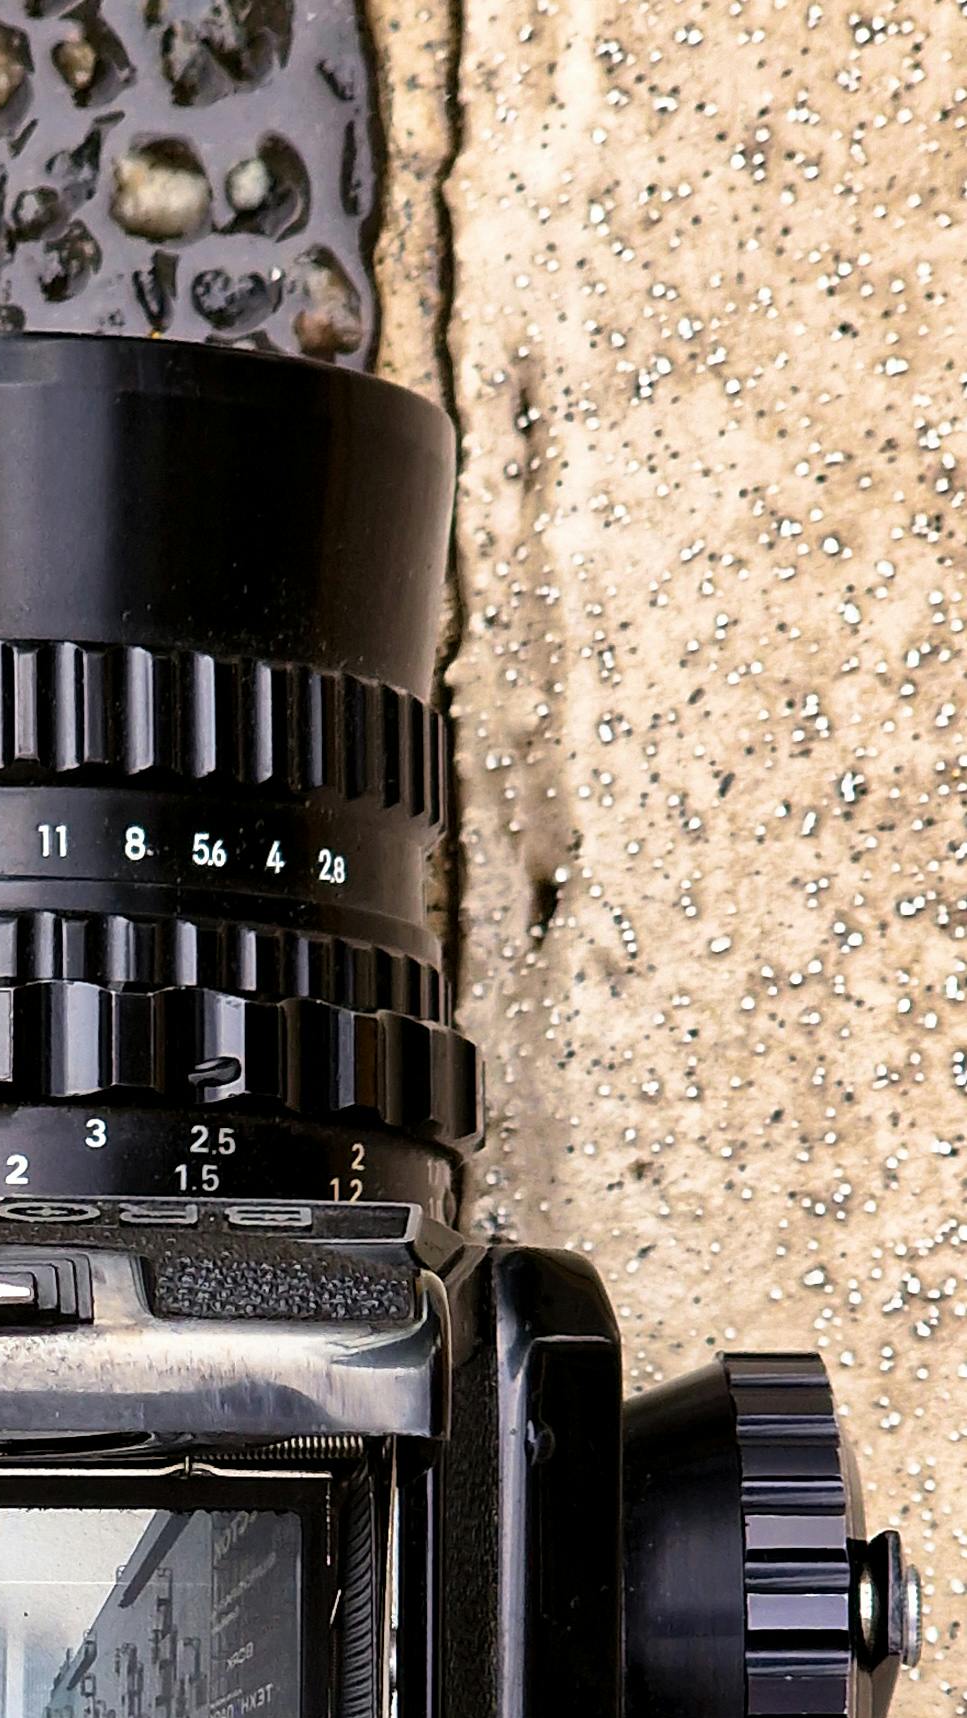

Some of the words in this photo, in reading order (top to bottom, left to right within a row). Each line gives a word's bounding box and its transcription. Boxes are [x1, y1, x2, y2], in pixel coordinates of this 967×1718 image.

[37, 824, 68, 858] 11
[124, 825, 146, 861] 8
[192, 832, 227, 868] 5.6
[265, 840, 286, 875] 4
[318, 848, 346, 884] 2.8
[85, 1118, 107, 1149] 3
[189, 1125, 236, 1155] 2.5
[351, 1143, 366, 1172] 2
[5, 1154, 29, 1185] 2
[174, 1164, 220, 1193] 1.5
